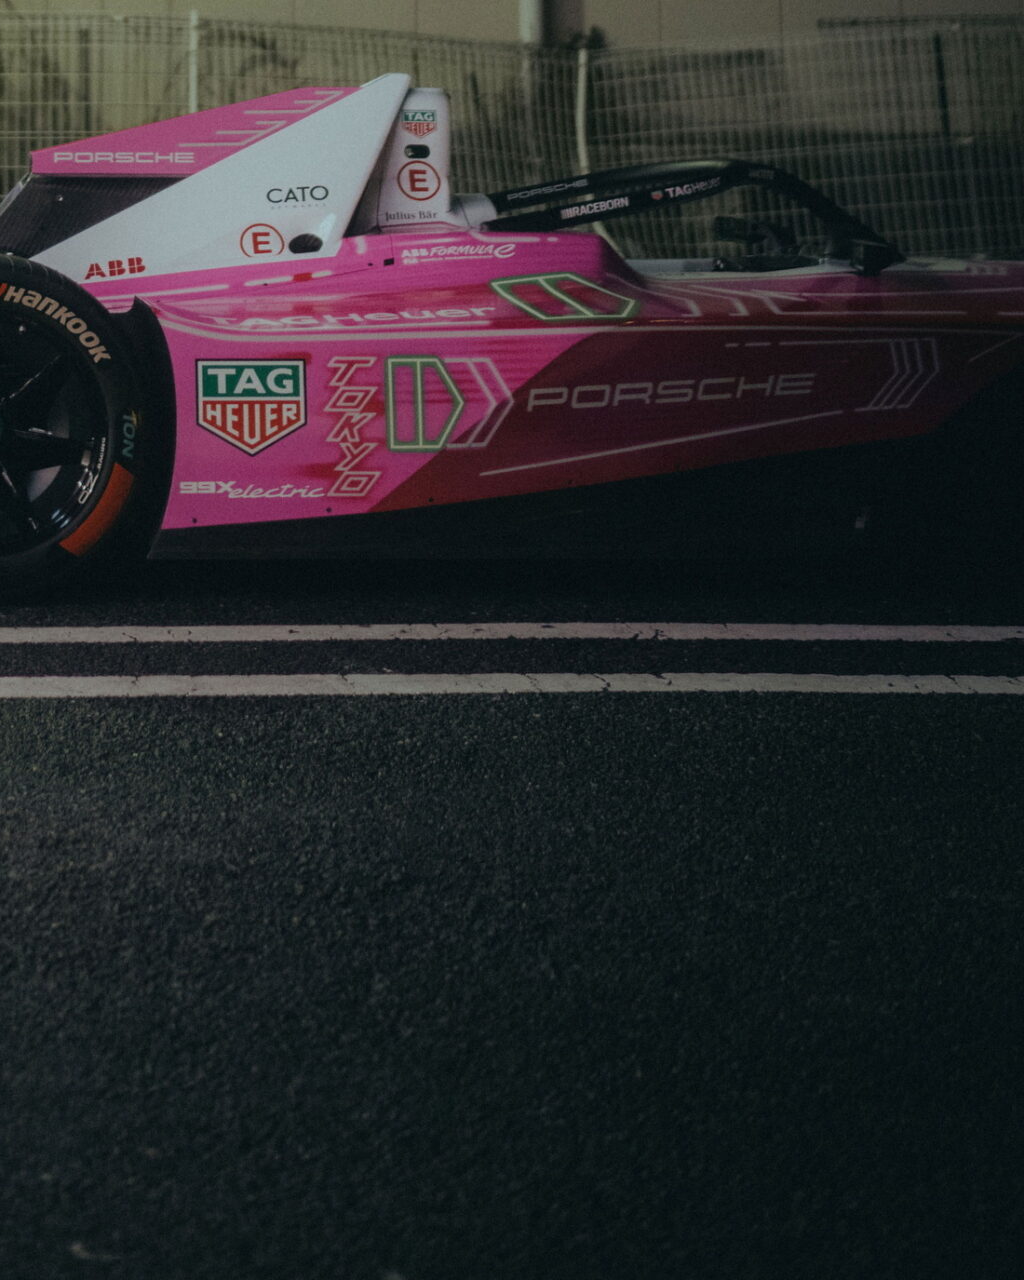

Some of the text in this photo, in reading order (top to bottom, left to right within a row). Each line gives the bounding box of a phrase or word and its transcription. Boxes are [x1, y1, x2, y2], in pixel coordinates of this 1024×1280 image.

[405, 112, 434, 121] TAG
[53, 151, 195, 164] PORSCHE
[266, 185, 329, 203] CATO
[506, 178, 589, 201] PORSCHE
[573, 196, 629, 218] RACEBORN
[84, 256, 146, 279] ABB
[207, 367, 294, 395] TAG
[527, 373, 816, 412] PORSCHE
[206, 401, 298, 446] HEUER
[324, 356, 381, 497] TOKYO
[228, 484, 325, 499] electric
